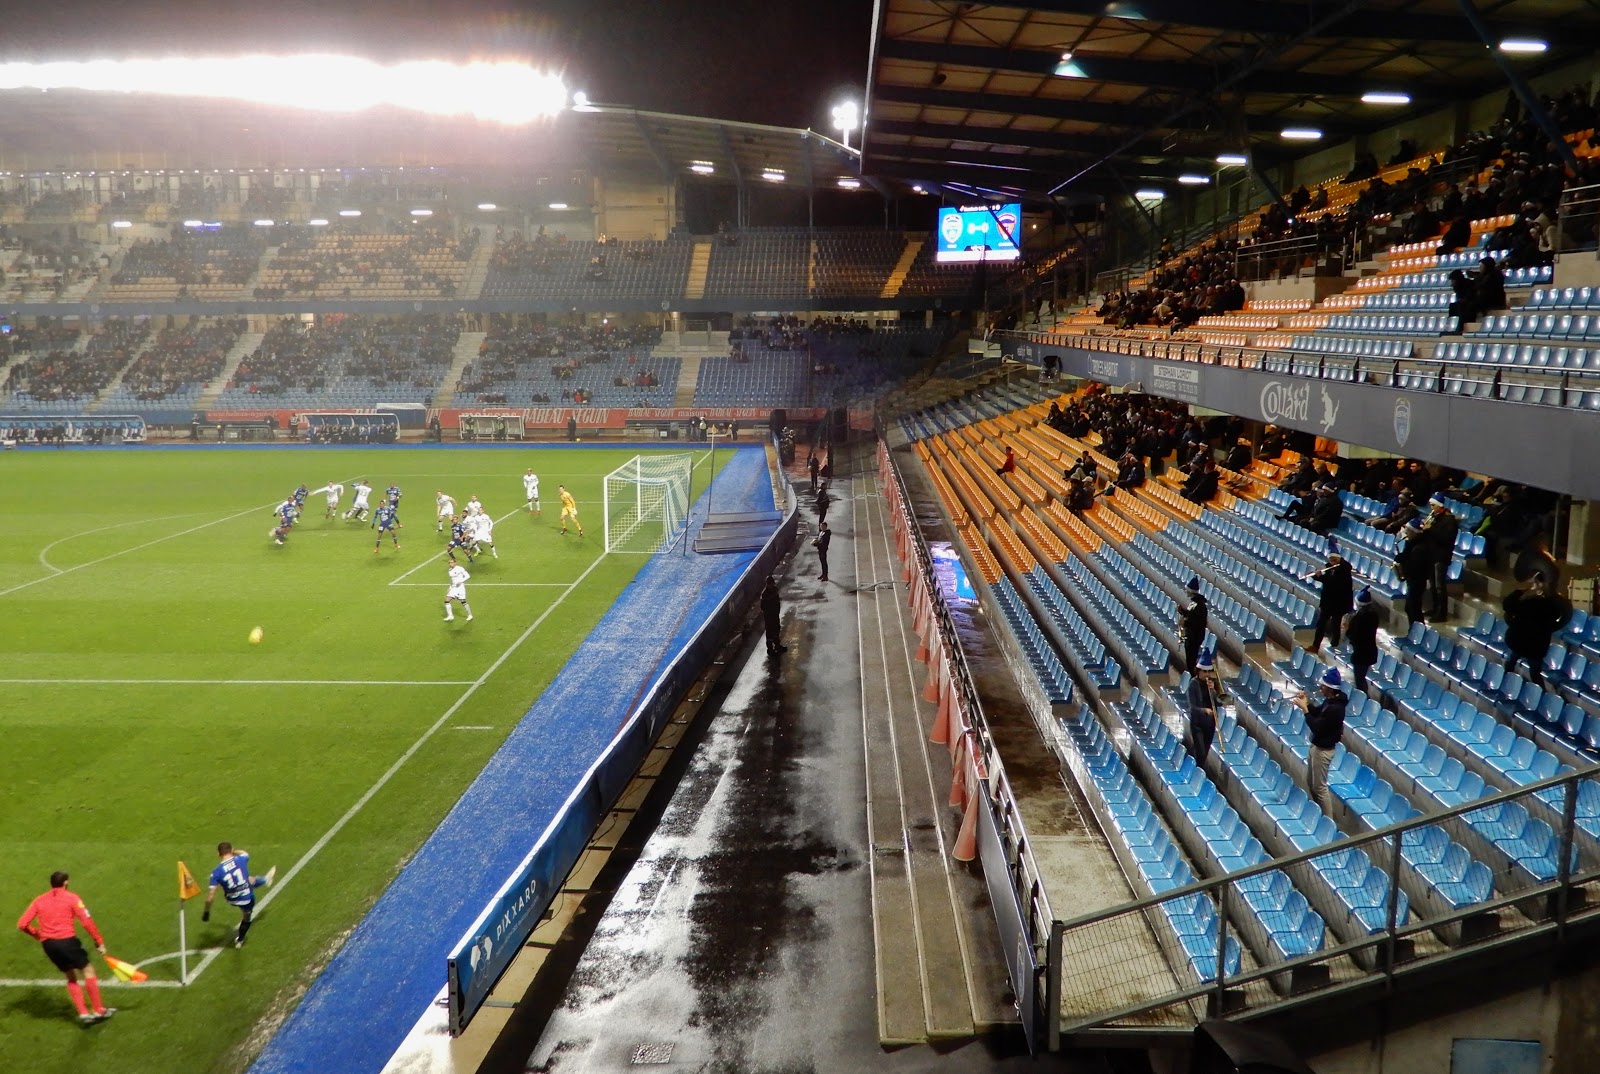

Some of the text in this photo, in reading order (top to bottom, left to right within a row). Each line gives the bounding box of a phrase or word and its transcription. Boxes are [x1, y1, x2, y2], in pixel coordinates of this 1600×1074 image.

[1103, 361, 1119, 378] HABITAT
[1260, 381, 1311, 422] Collard
[223, 868, 247, 889] 11
[496, 879, 537, 941] PIXXARO
